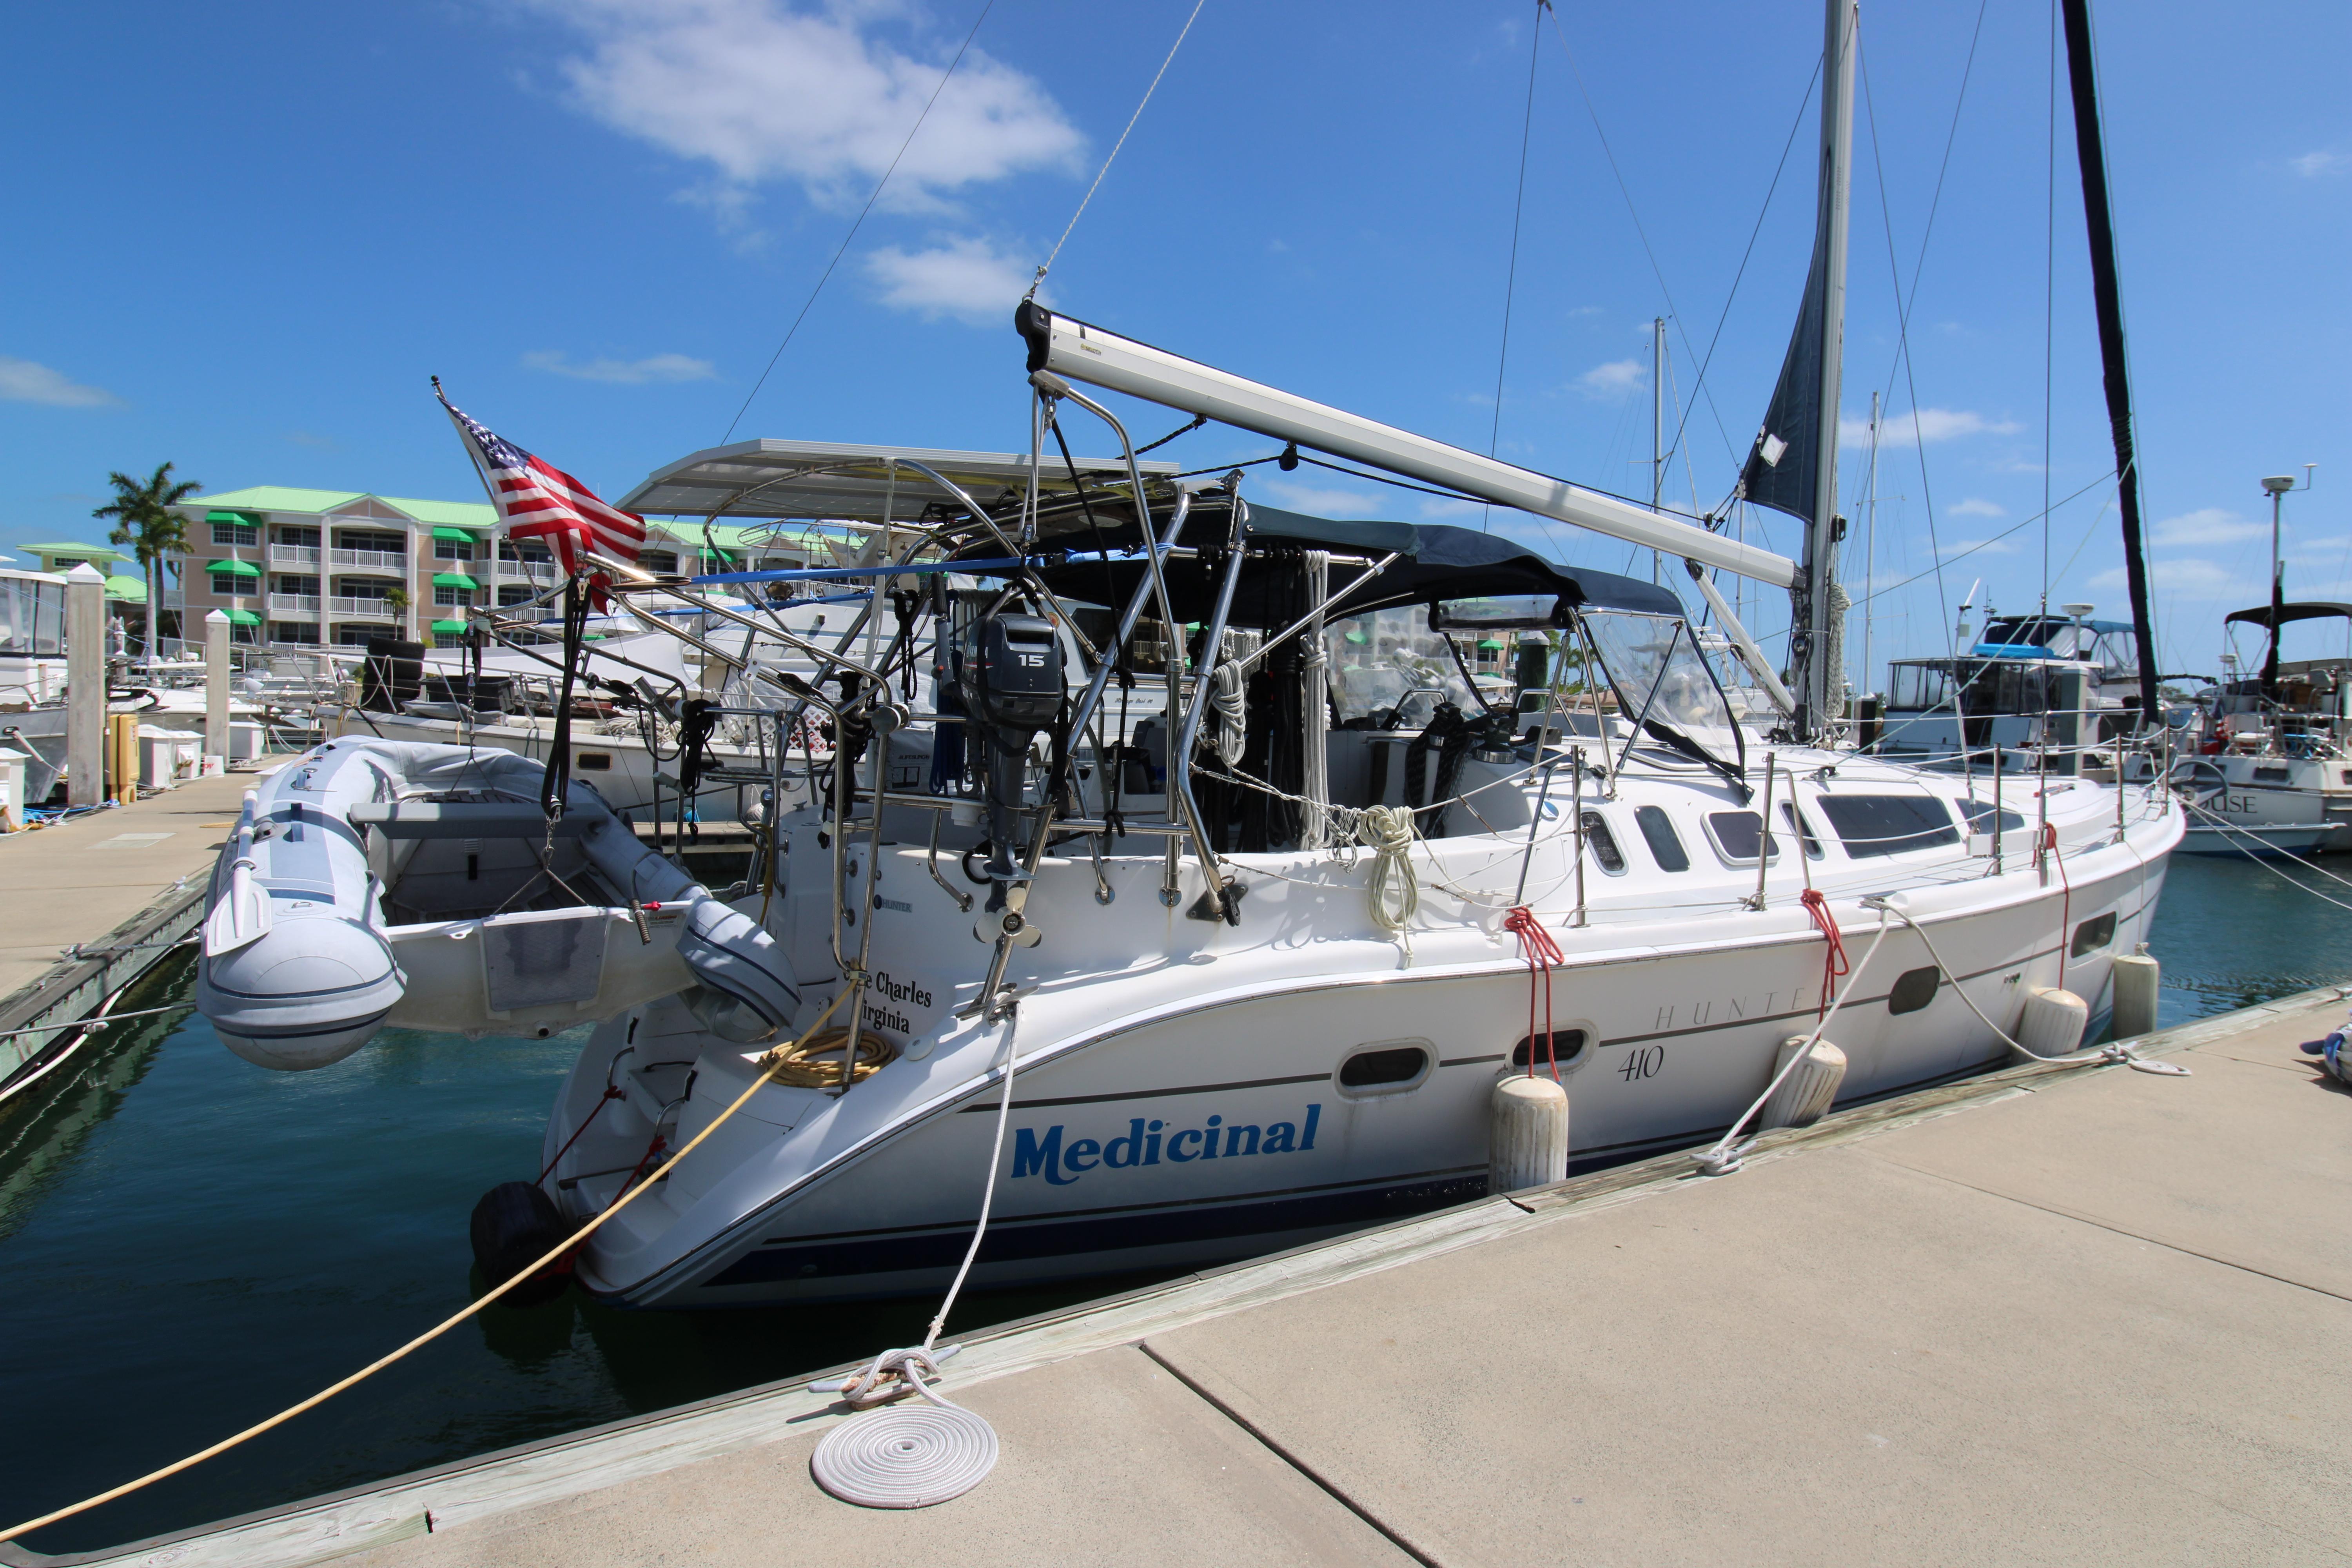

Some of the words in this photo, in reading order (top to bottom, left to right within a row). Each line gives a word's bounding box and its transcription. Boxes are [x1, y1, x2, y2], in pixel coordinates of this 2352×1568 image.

[1018, 654, 1045, 667] 15
[882, 898, 912, 913] HUNTER
[876, 971, 932, 1008] Charles
[863, 999, 910, 1034] irginia
[1617, 1045, 1664, 1082] 410
[1011, 1103, 1321, 1185] Medicinal
